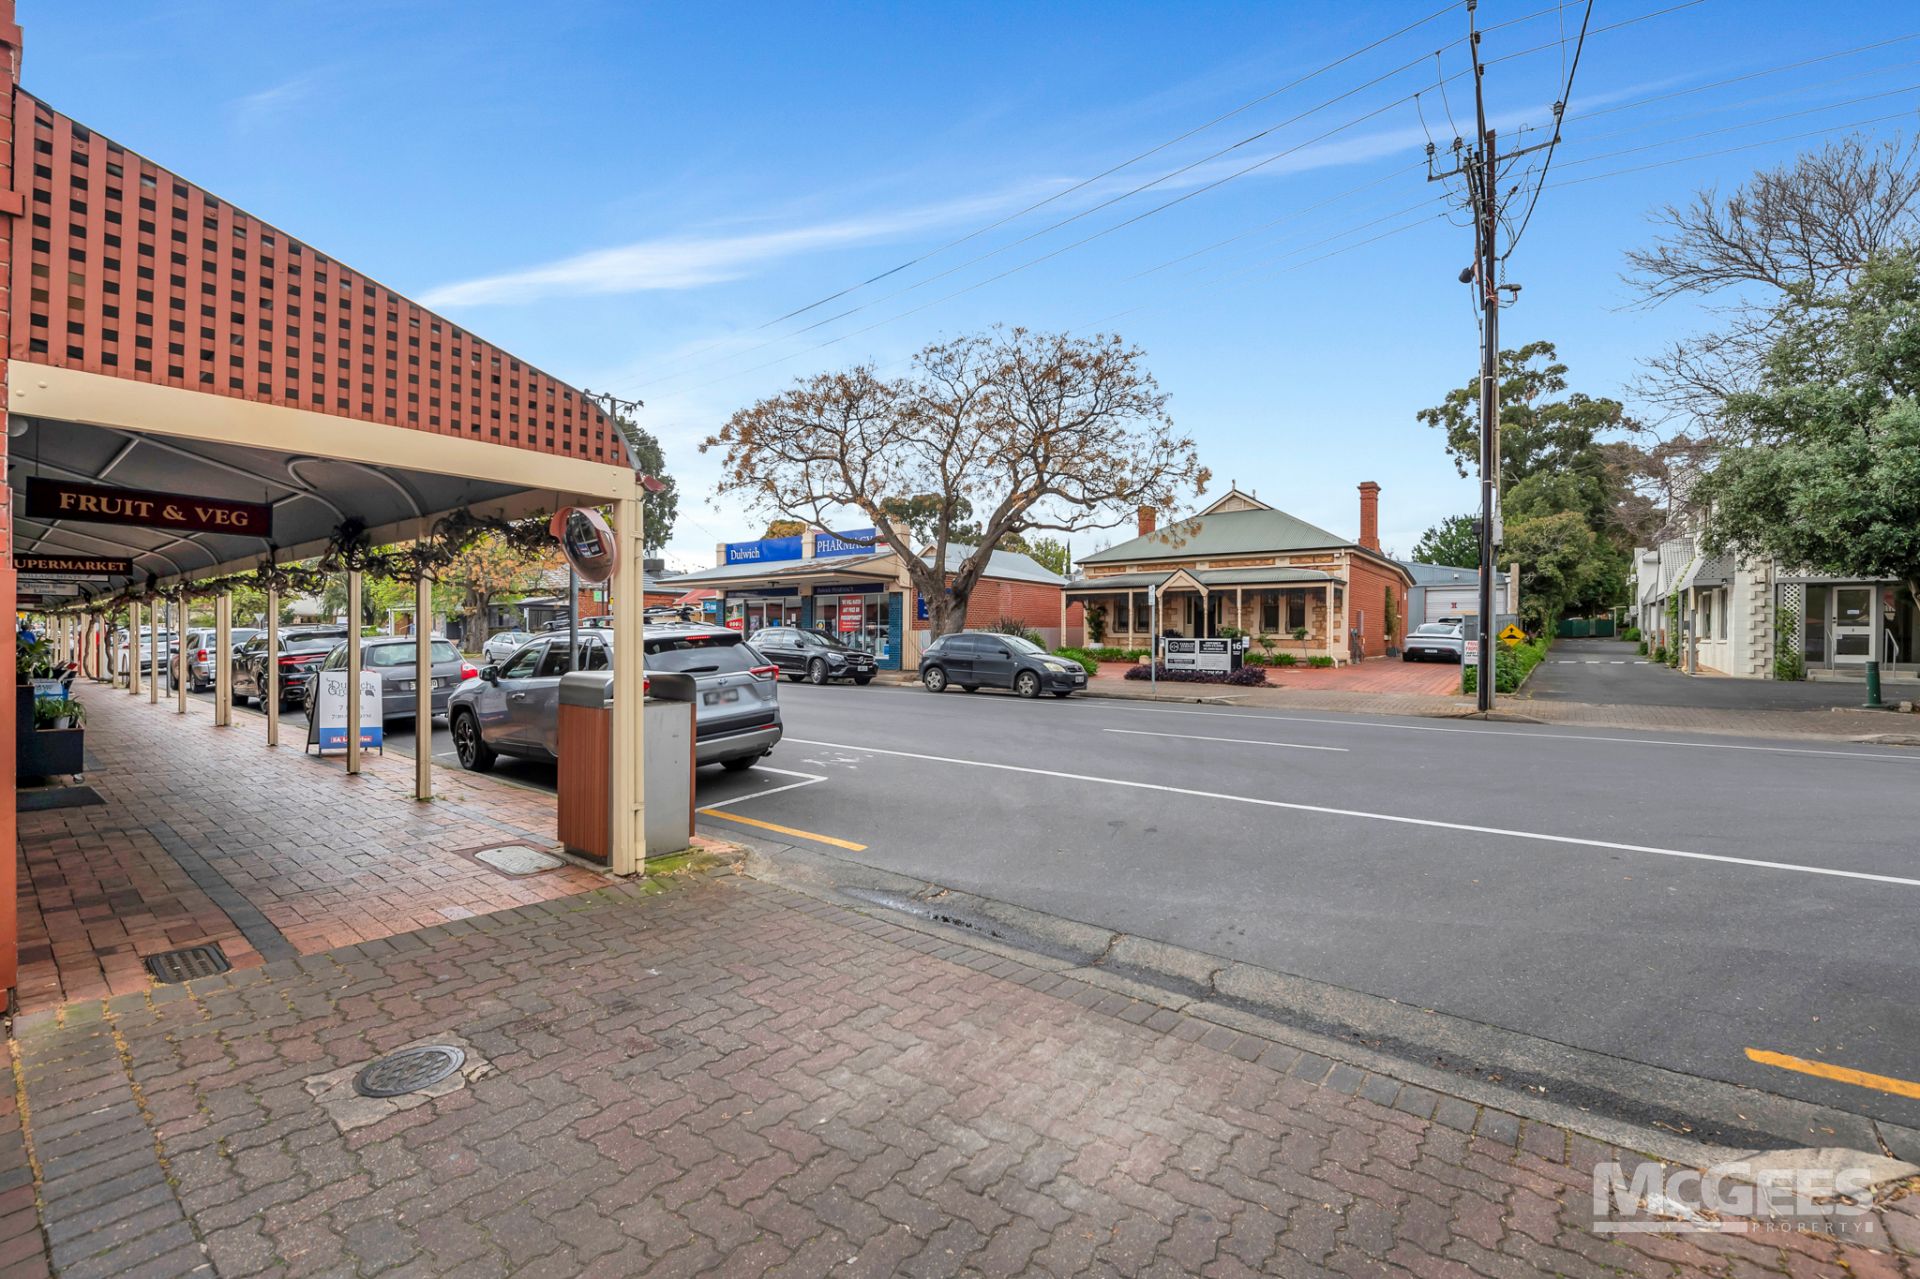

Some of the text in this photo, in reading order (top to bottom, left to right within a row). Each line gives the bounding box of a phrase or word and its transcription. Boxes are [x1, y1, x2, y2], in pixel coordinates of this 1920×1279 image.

[59, 492, 249, 526] FRUIT & VEG
[730, 547, 760, 561] Dulwich
[13, 559, 127, 571] UPERMARKET
[1232, 642, 1242, 650] 16
